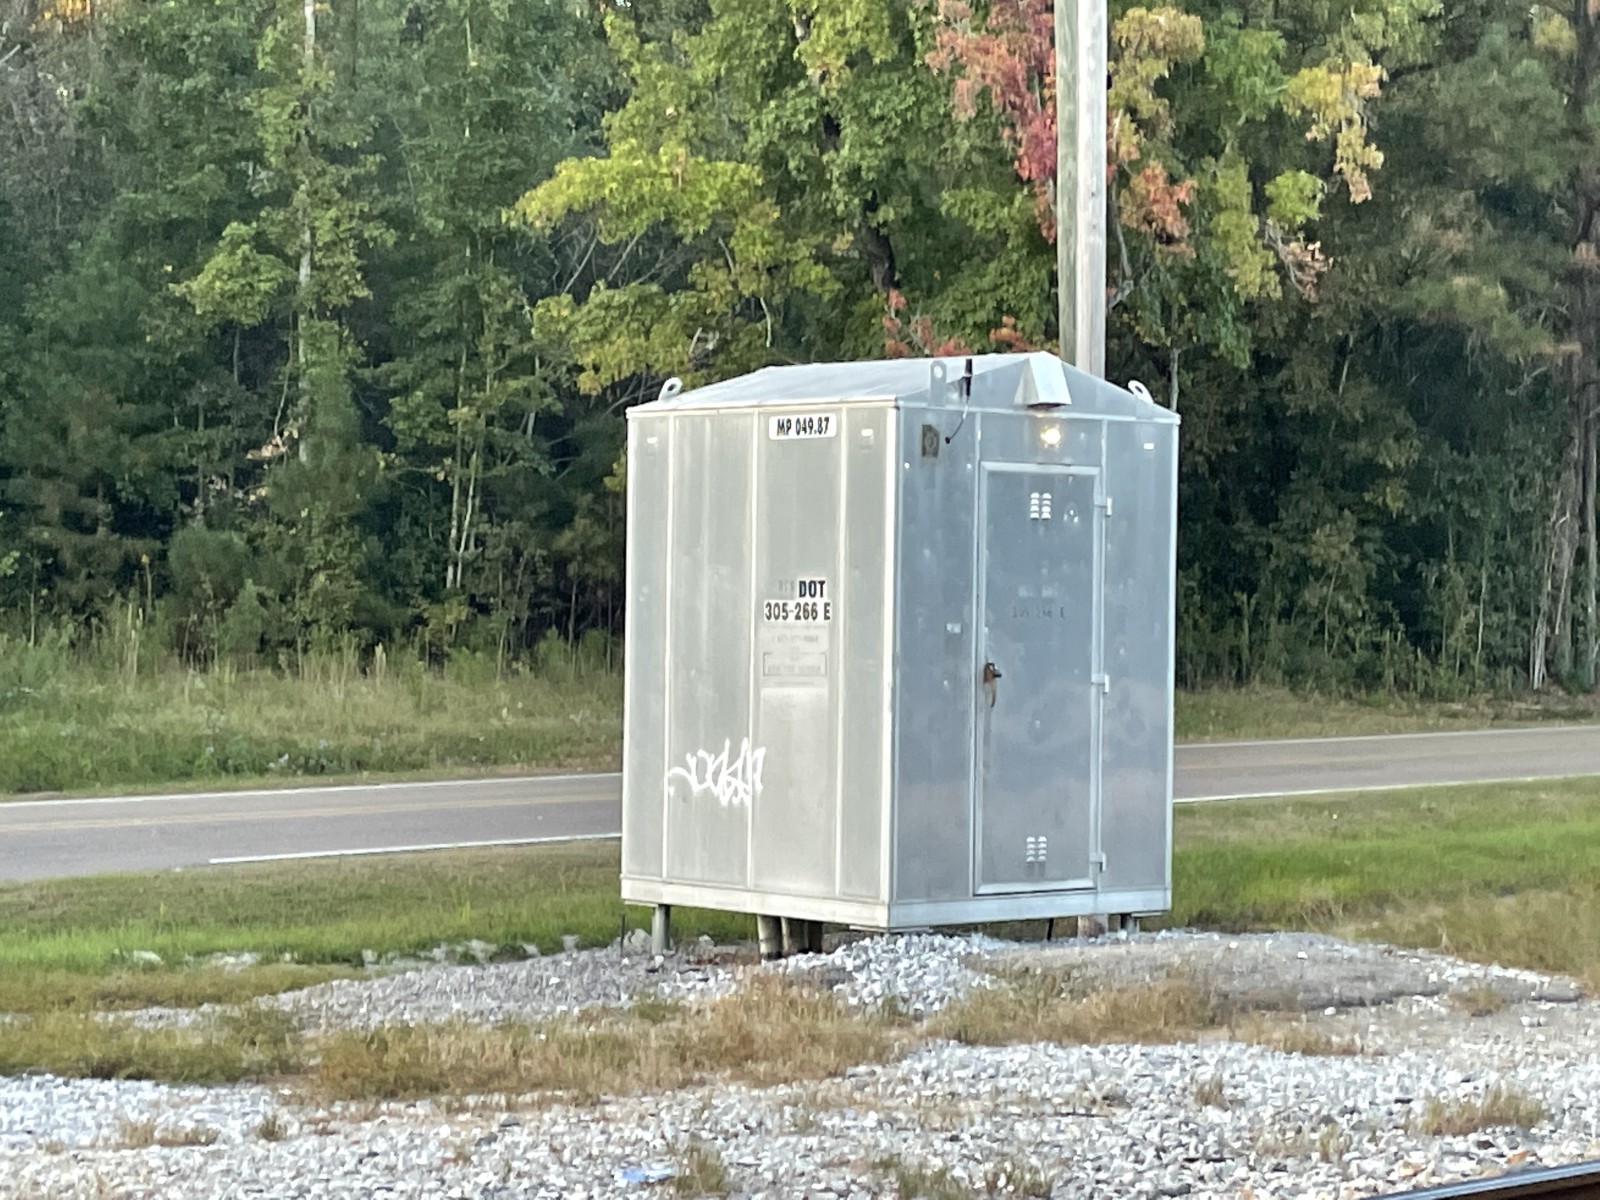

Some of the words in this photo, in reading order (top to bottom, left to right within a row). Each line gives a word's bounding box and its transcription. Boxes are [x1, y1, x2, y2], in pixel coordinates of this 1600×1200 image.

[777, 417, 792, 436] MP
[796, 416, 830, 436] 049.87
[798, 580, 826, 598] DOT
[764, 601, 818, 621] 305-266
[823, 602, 831, 621] E
